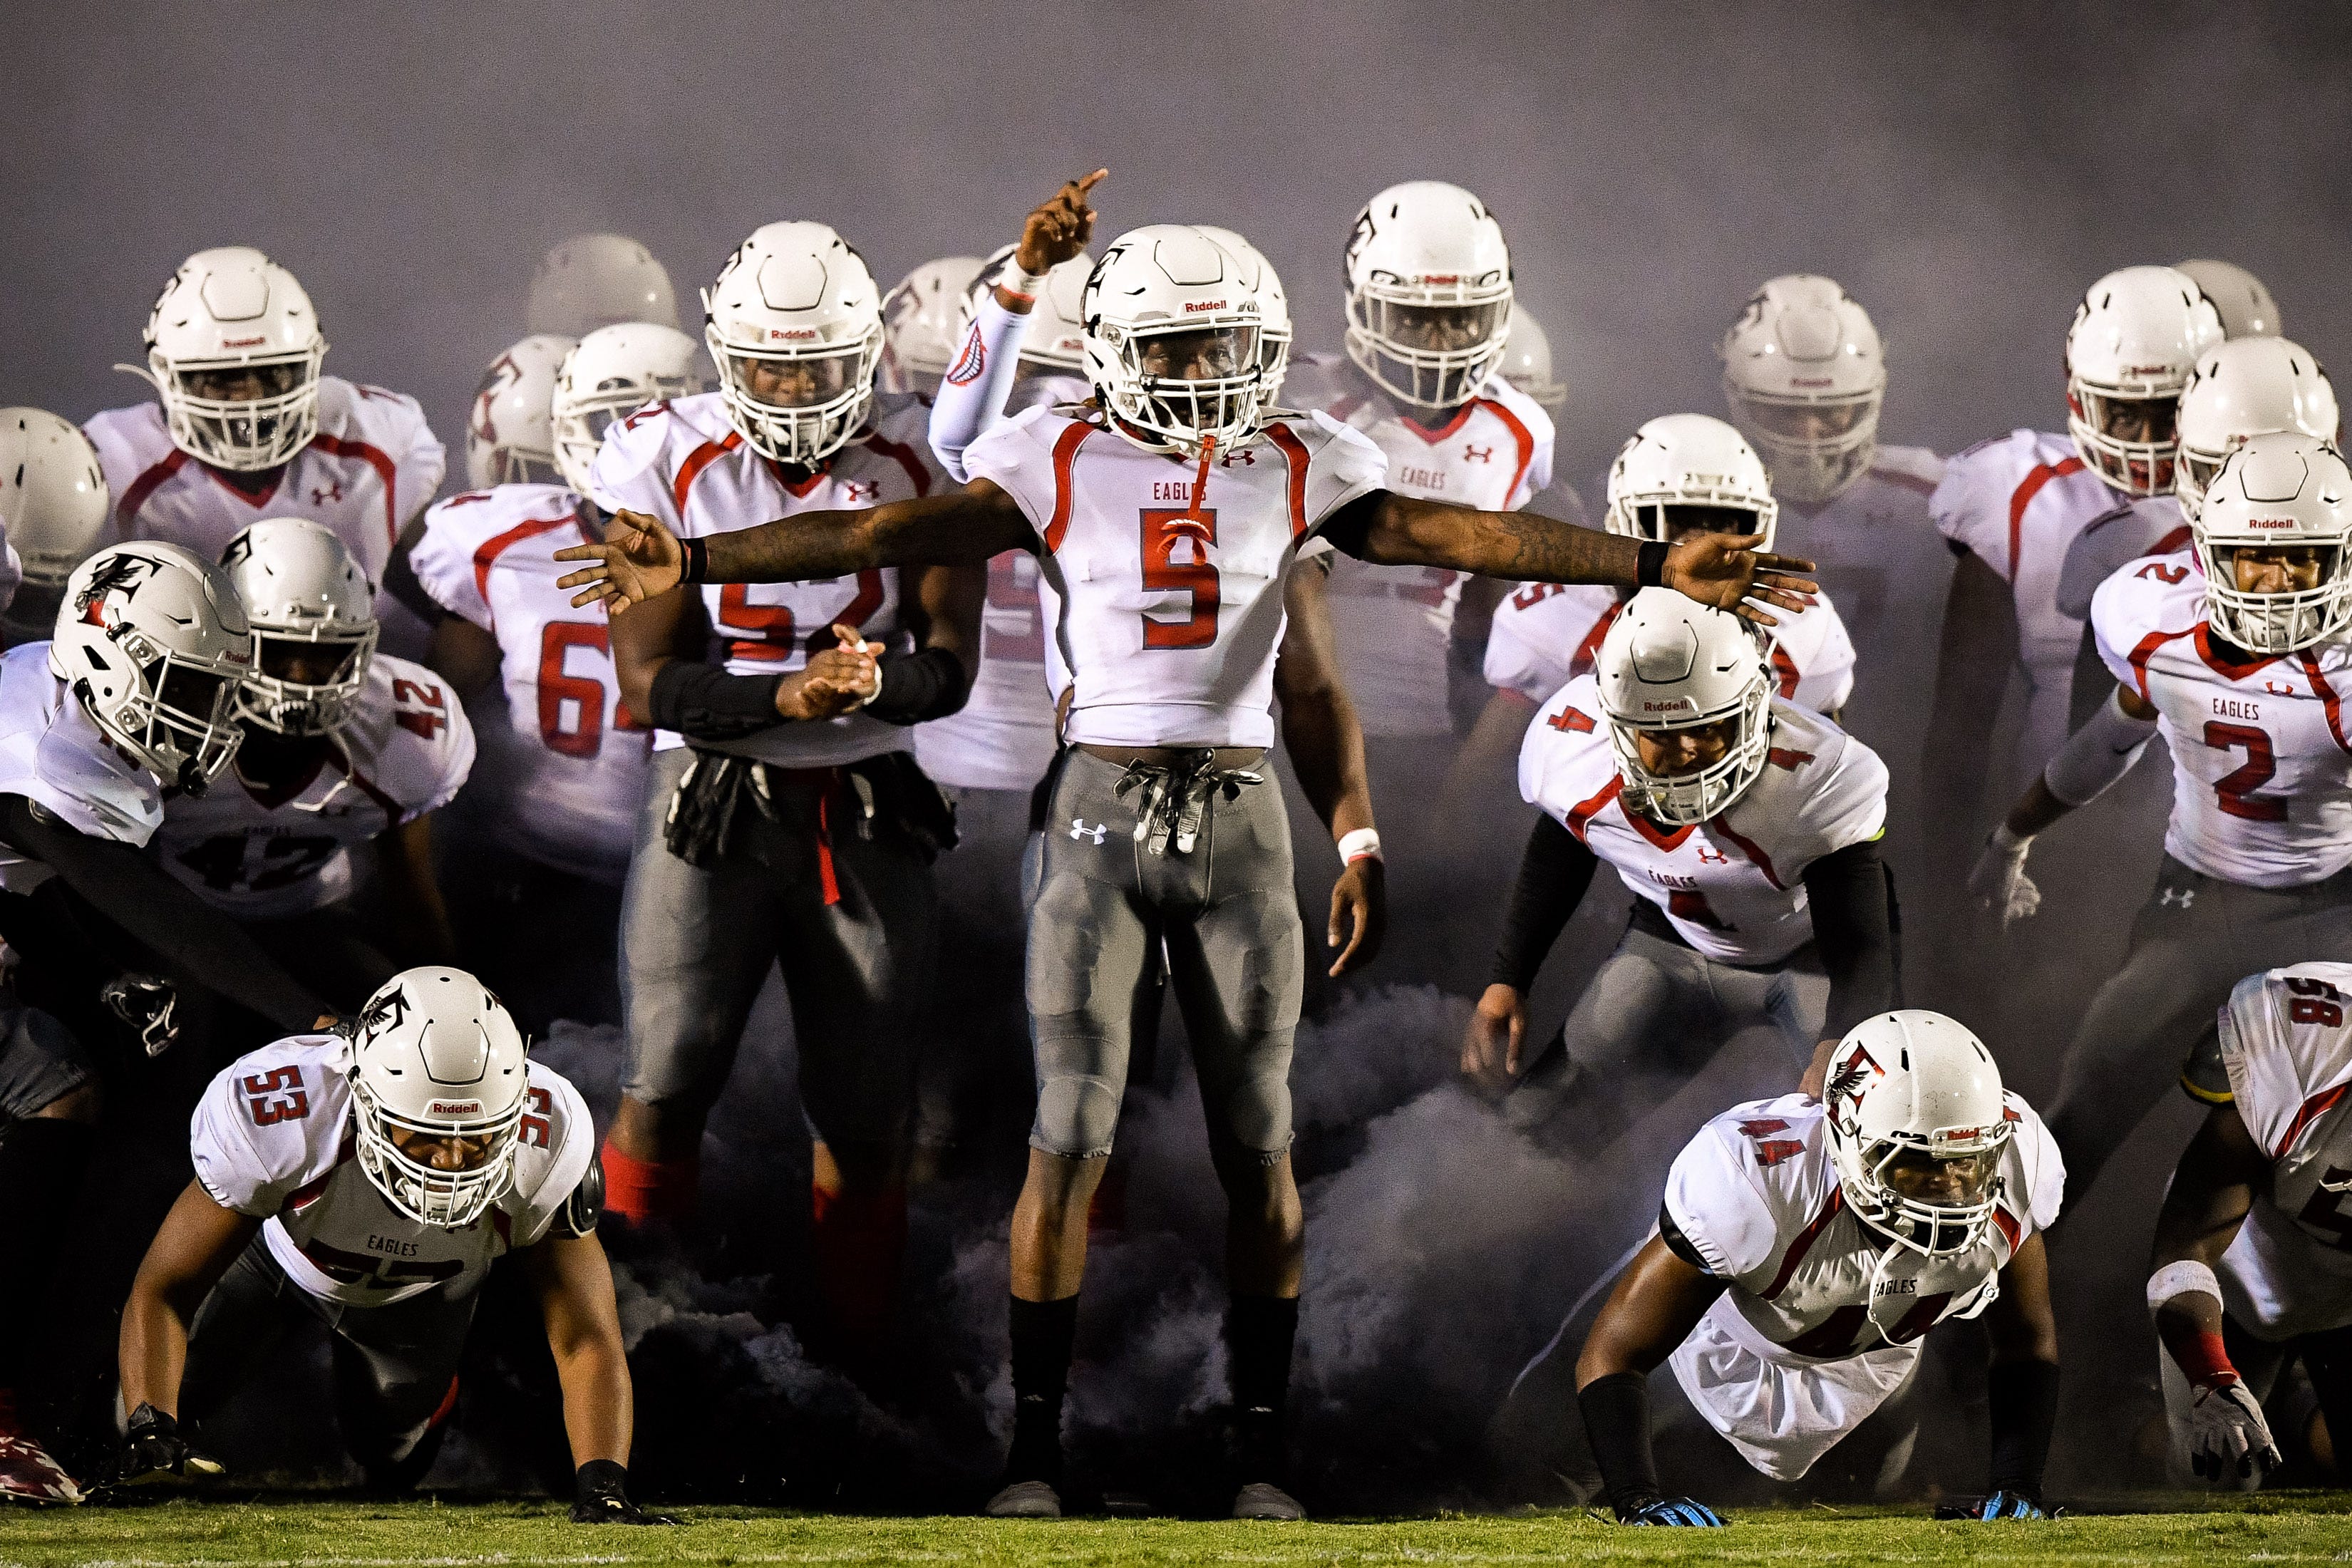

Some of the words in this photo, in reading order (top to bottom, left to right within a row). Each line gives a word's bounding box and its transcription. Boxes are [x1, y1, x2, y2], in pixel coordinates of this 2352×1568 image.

[1185, 300, 1227, 312] Riddell
[1154, 483, 1207, 500] EAGL
[2249, 518, 2293, 528] Riddell
[1139, 508, 1221, 650] 5
[2133, 563, 2189, 584] 2
[393, 679, 448, 740] 42
[1644, 700, 1688, 711] Riddell
[2213, 698, 2259, 720] EAGLES
[1546, 705, 1598, 734] 4
[2203, 720, 2289, 822] 2
[2283, 976, 2343, 1028] 58
[242, 1064, 310, 1127] 53
[433, 1103, 478, 1113] Riddell
[368, 1234, 419, 1257] EAGLES
